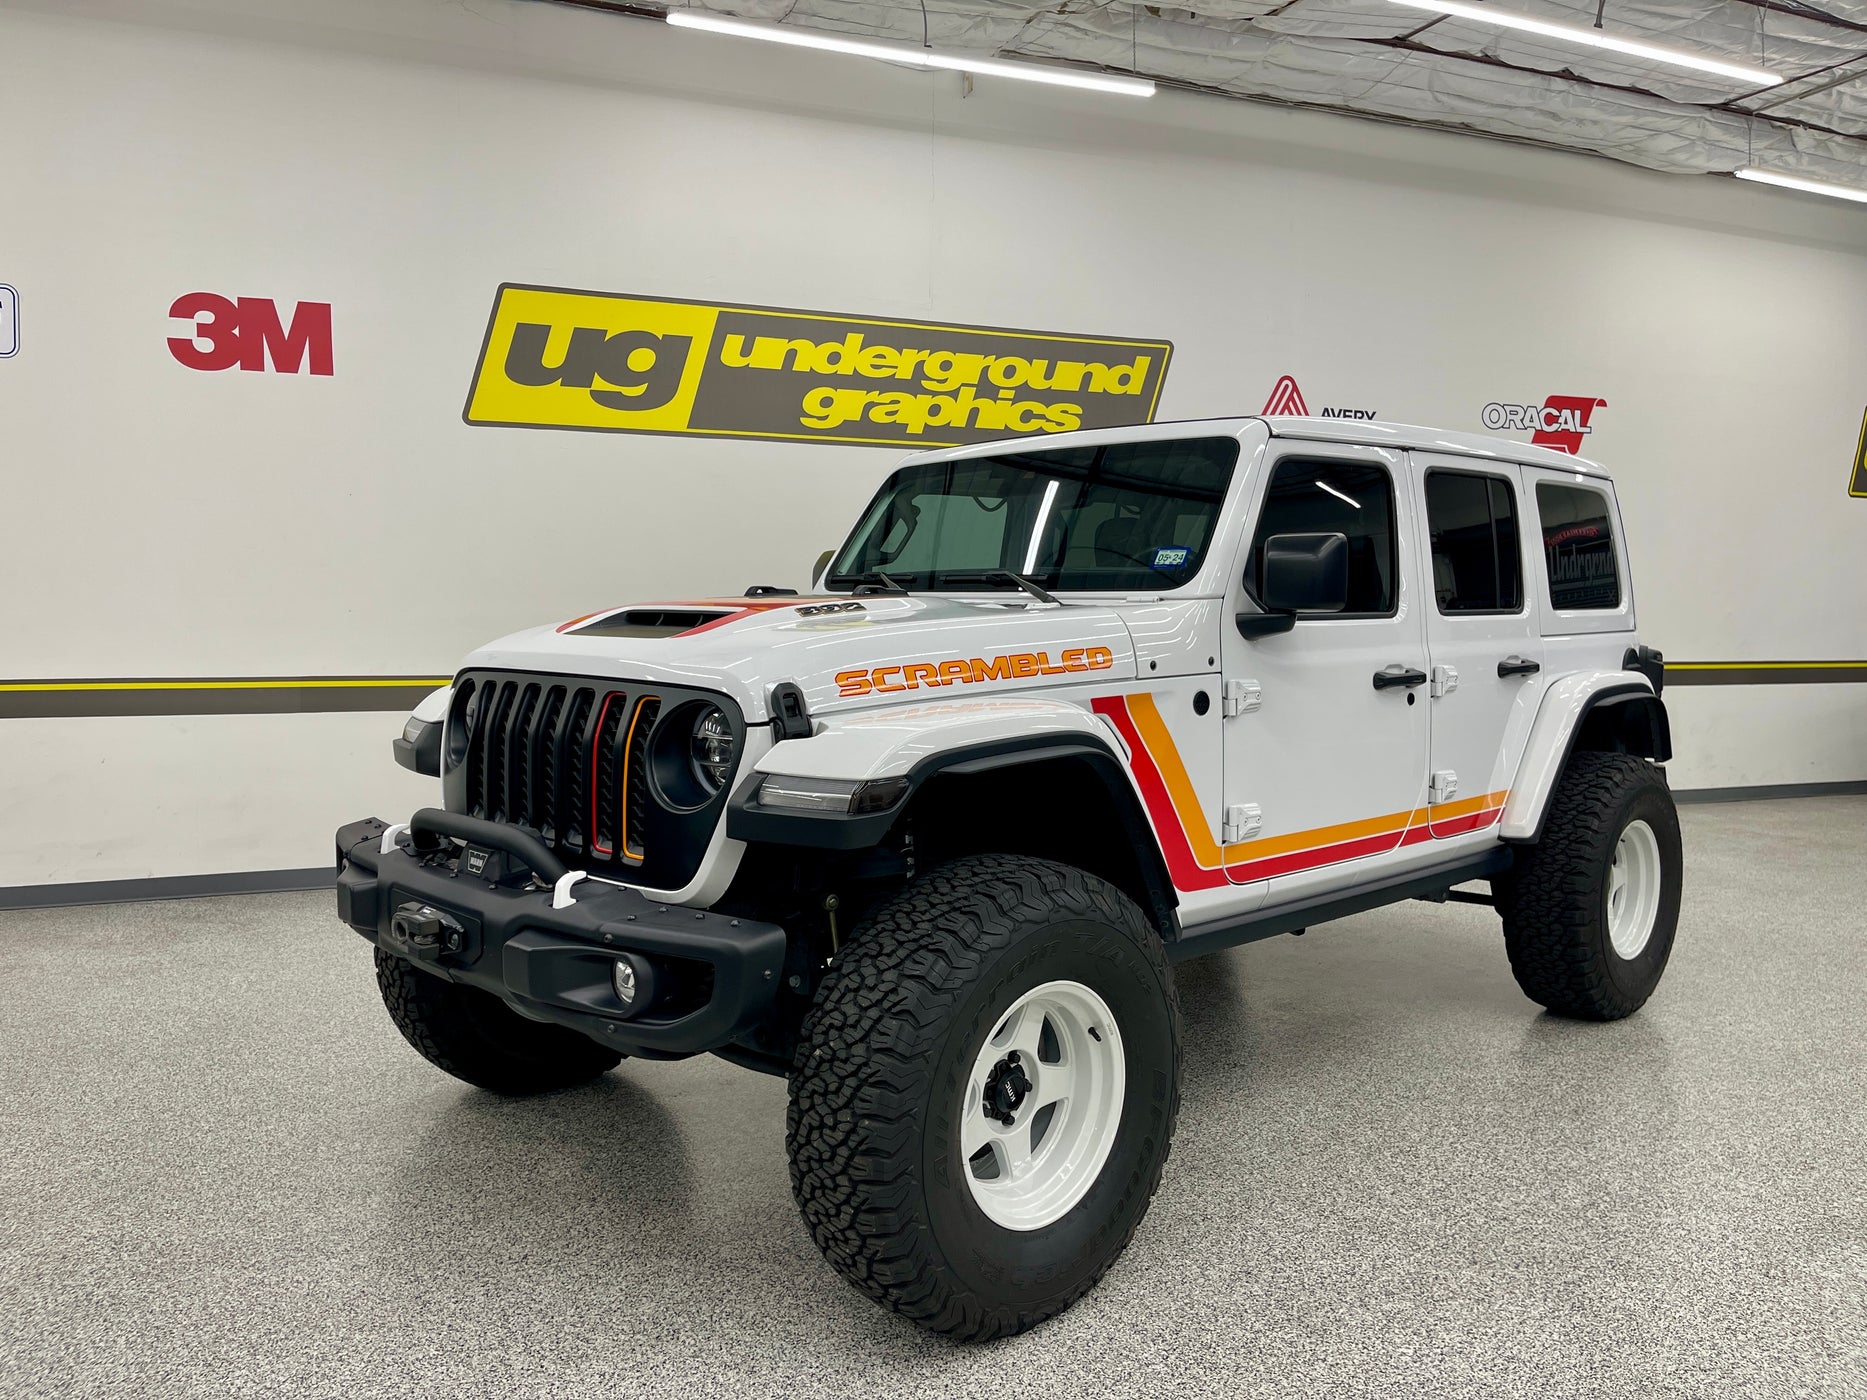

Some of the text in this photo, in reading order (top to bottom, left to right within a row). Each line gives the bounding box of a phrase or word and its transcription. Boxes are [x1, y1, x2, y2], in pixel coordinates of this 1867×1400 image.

[166, 292, 334, 377] 3M
[503, 322, 694, 412] ug
[719, 333, 1152, 396] underground
[799, 386, 1083, 434] graphics
[1481, 402, 1592, 434] ORACAL
[834, 646, 1113, 698] SCRAMBLED
